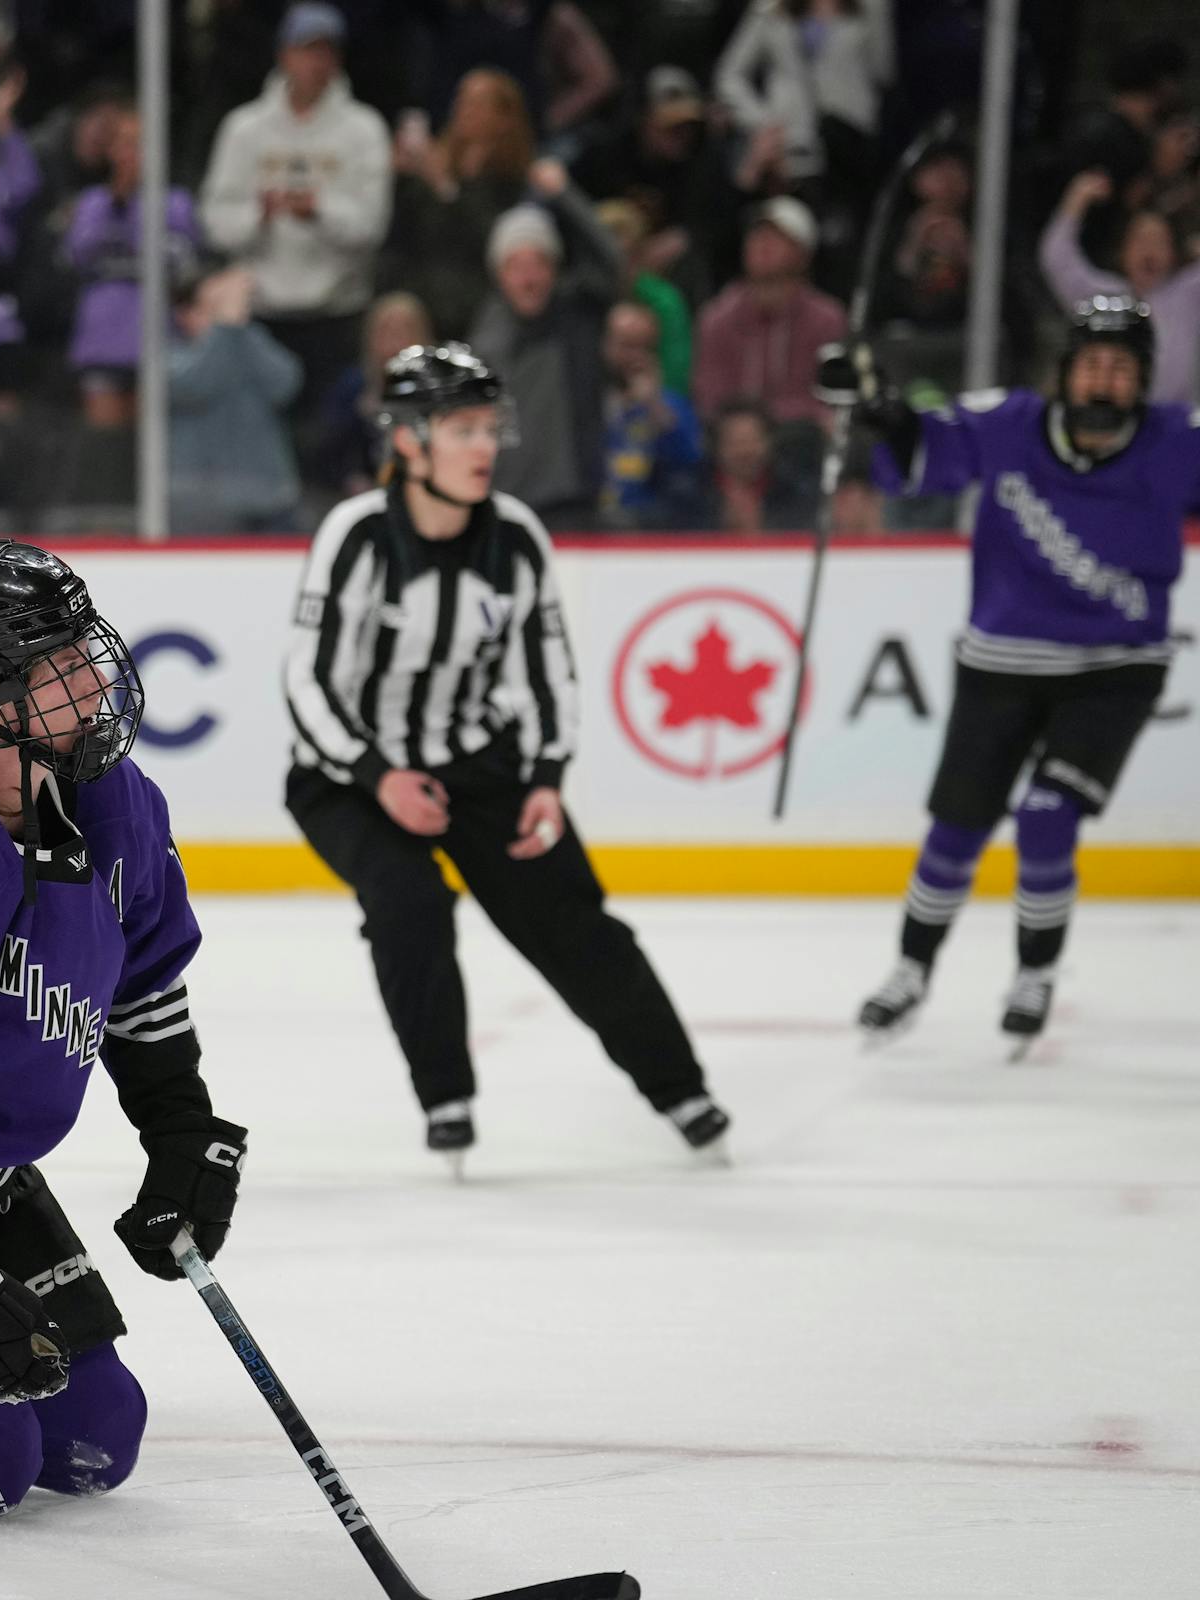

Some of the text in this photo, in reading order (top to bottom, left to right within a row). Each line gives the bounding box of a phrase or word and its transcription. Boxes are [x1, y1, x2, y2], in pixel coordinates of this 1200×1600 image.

[147, 1212, 178, 1226] CCM
[24, 1252, 100, 1298] CCM
[302, 1446, 372, 1534] CCM
